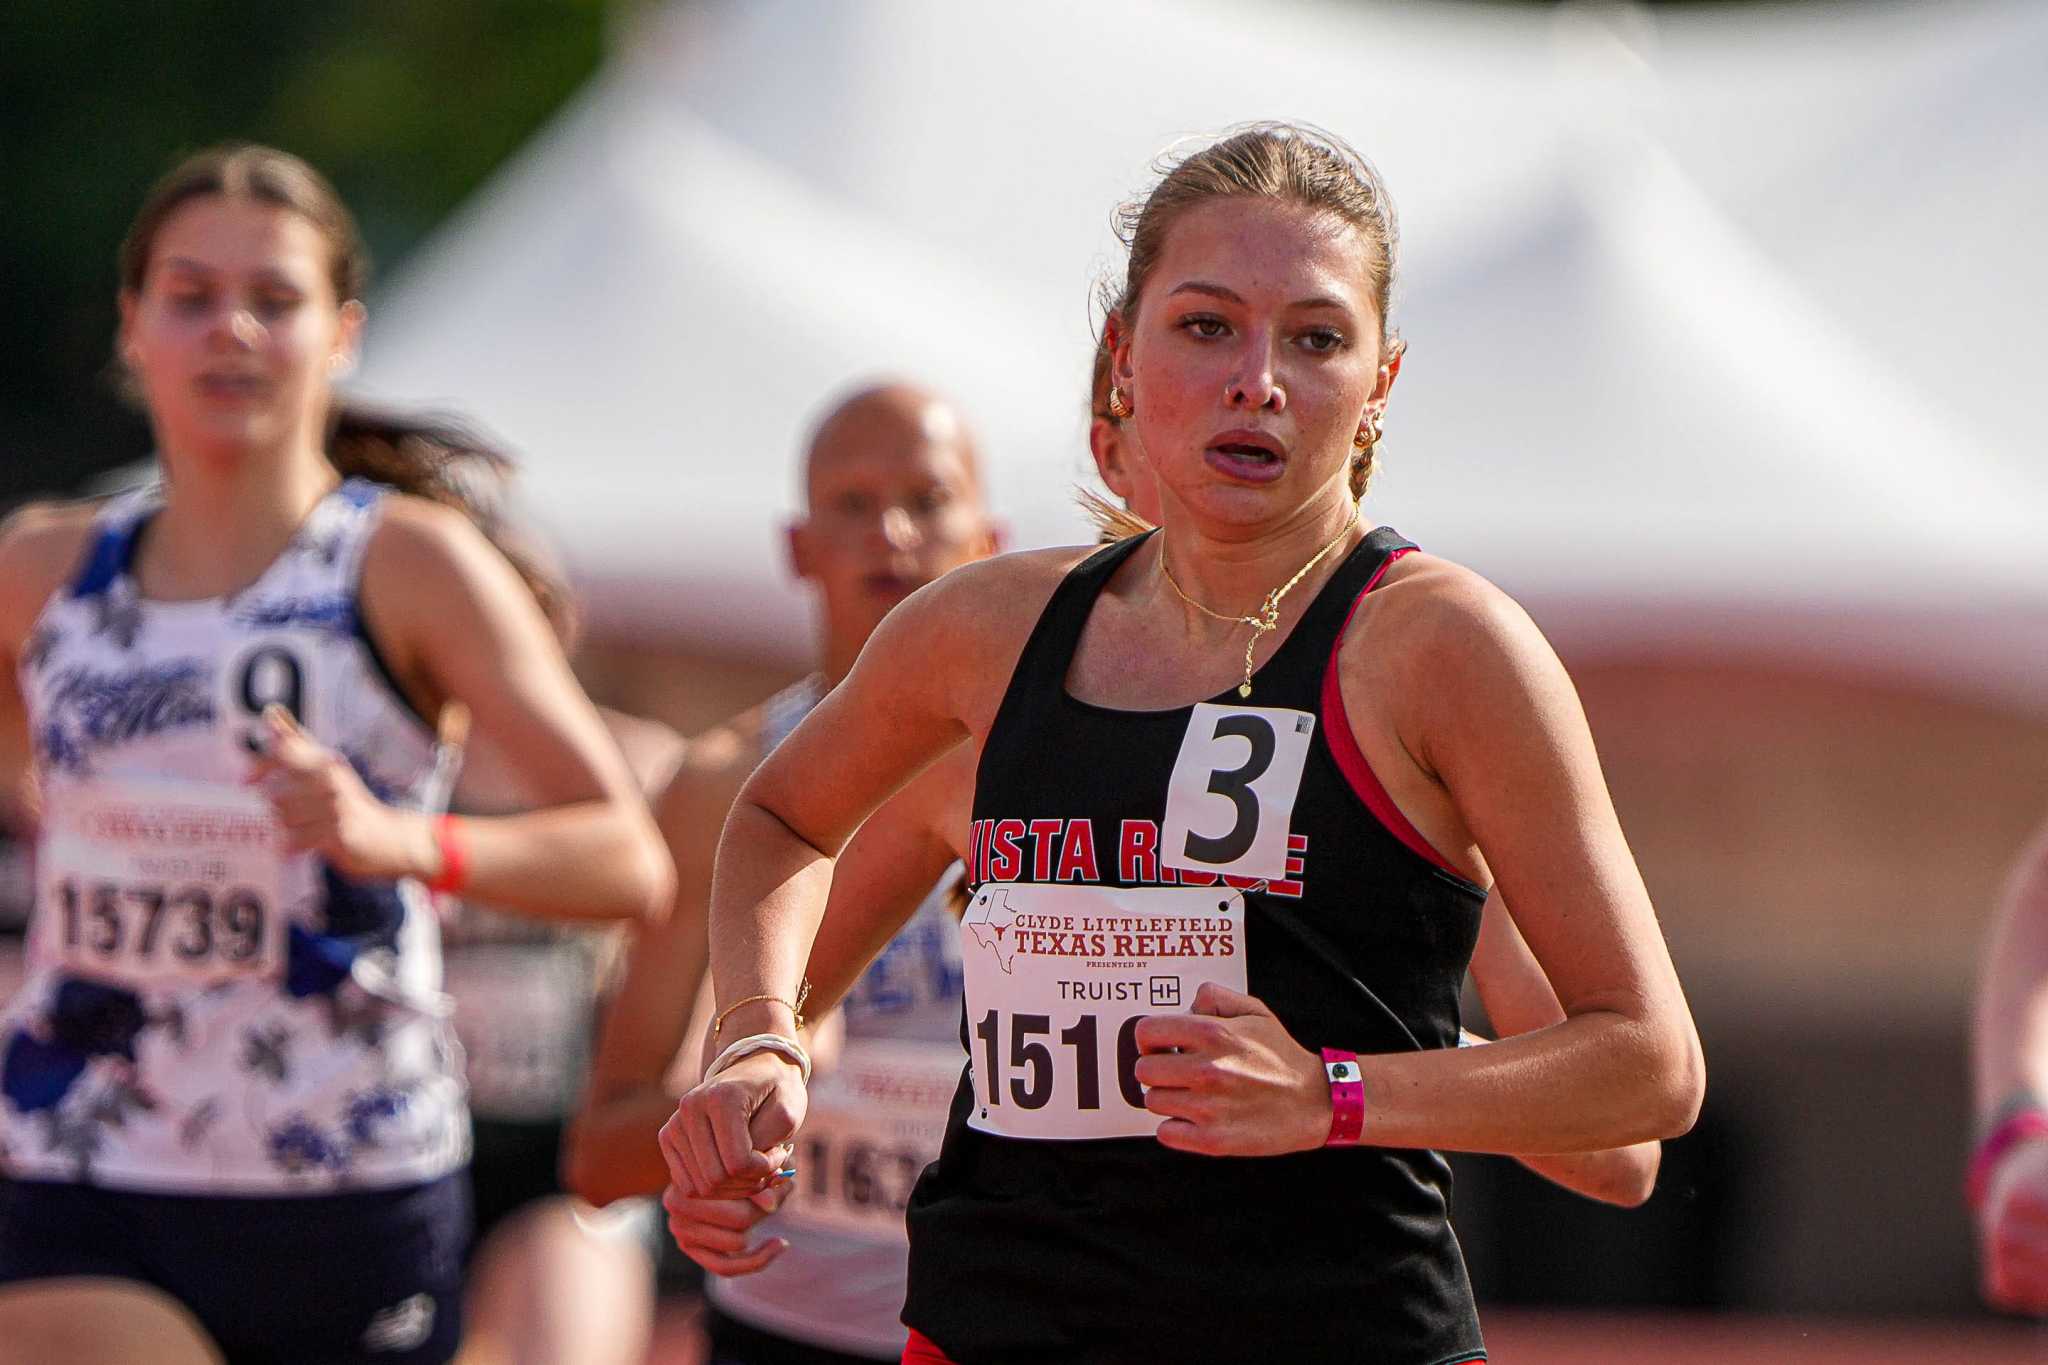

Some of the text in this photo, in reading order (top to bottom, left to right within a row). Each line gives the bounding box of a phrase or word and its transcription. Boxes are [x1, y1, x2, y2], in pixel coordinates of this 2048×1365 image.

[1182, 712, 1277, 866] 3
[60, 875, 267, 963] 15739
[1015, 913, 1233, 932] CLYDE LITTLEFIELD
[1014, 930, 1235, 957] TEXAS RELAYS
[1086, 960, 1148, 969] PRESENTED BY
[1056, 980, 1143, 1001] TRUIST
